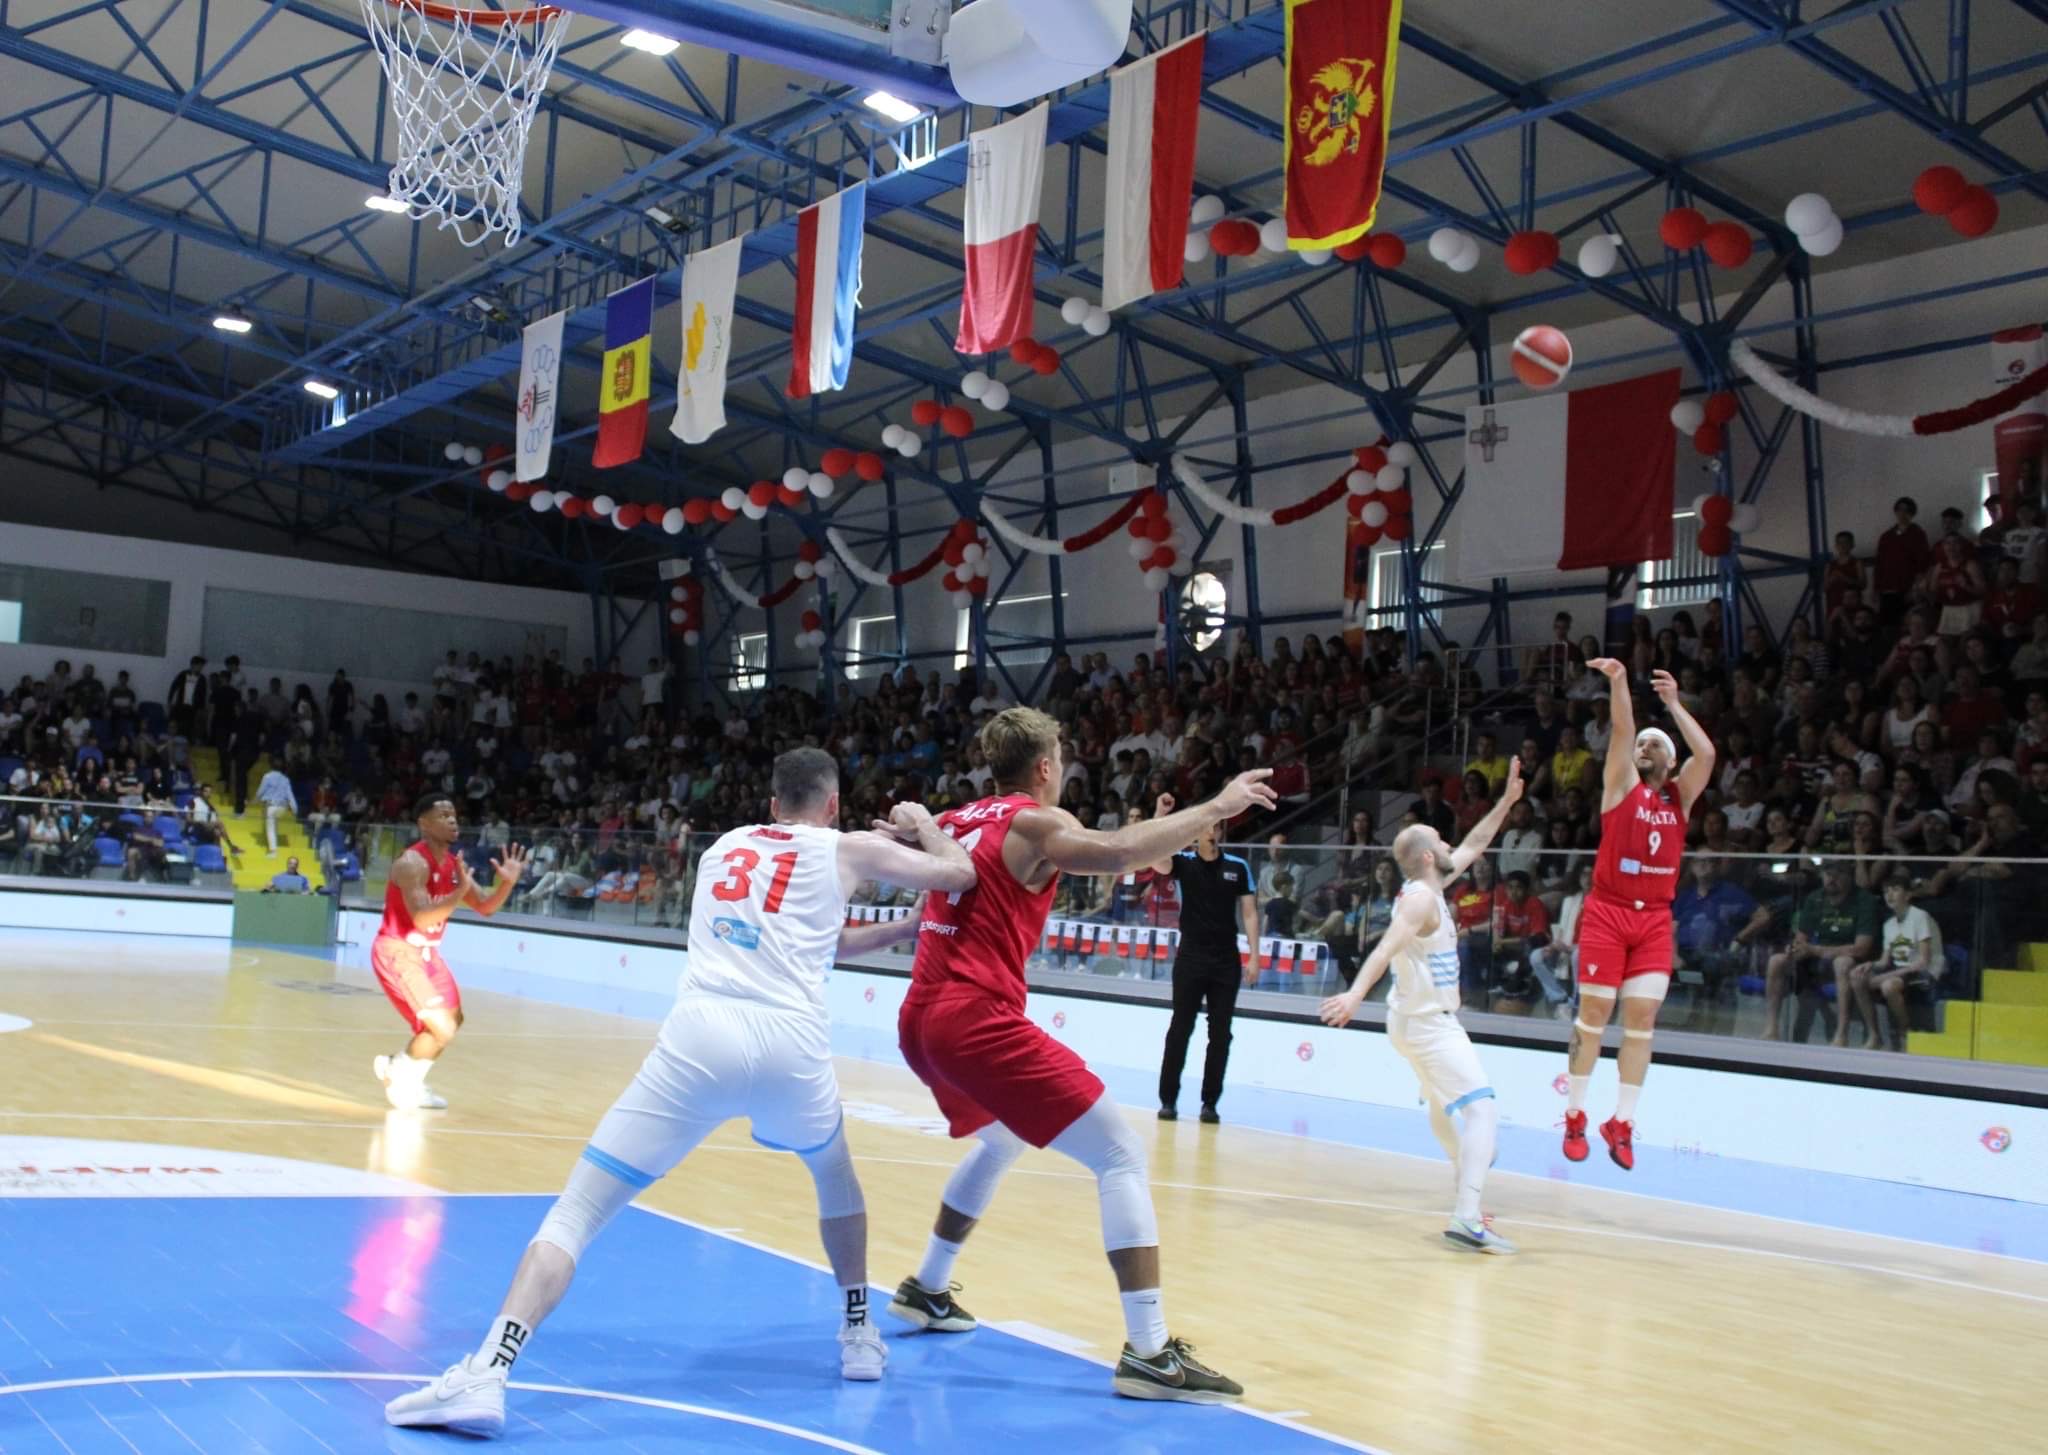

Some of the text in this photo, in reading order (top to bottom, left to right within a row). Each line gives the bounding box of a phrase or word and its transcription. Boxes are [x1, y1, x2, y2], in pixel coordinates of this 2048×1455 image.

[1635, 805, 1678, 825] MALTA
[1647, 830, 1662, 856] 9
[711, 847, 799, 914] 31
